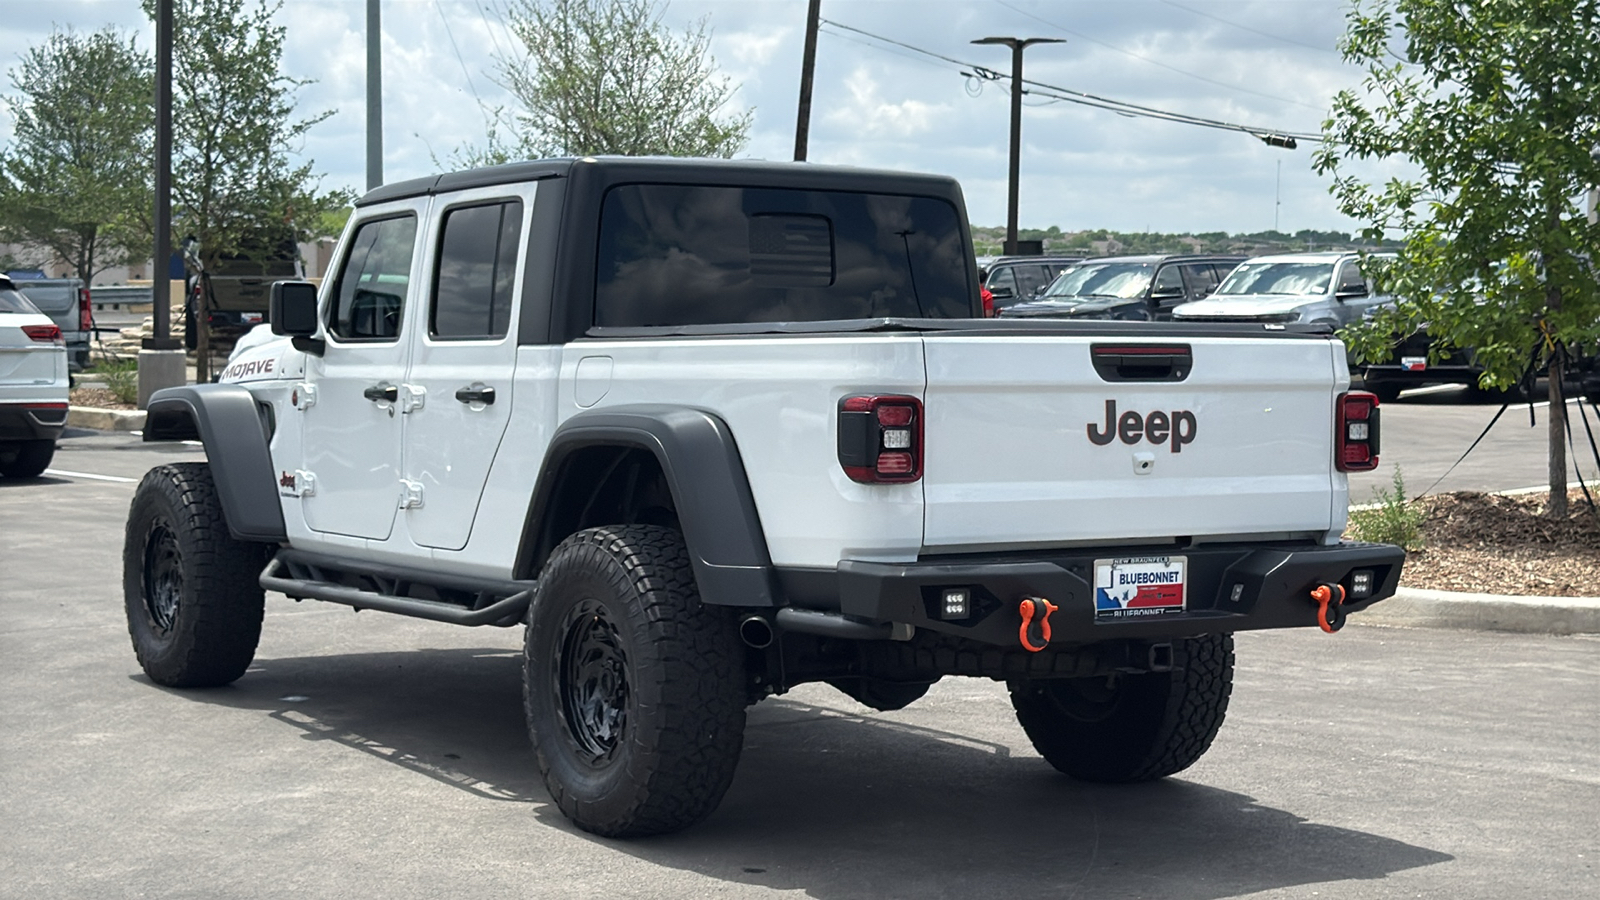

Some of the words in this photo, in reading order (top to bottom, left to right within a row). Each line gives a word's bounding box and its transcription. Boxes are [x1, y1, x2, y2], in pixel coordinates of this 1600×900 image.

[222, 358, 275, 379] MOJAVE
[1087, 399, 1197, 453] Jeep
[280, 470, 296, 491] Jeep
[1119, 571, 1179, 584] BLUEBONNET
